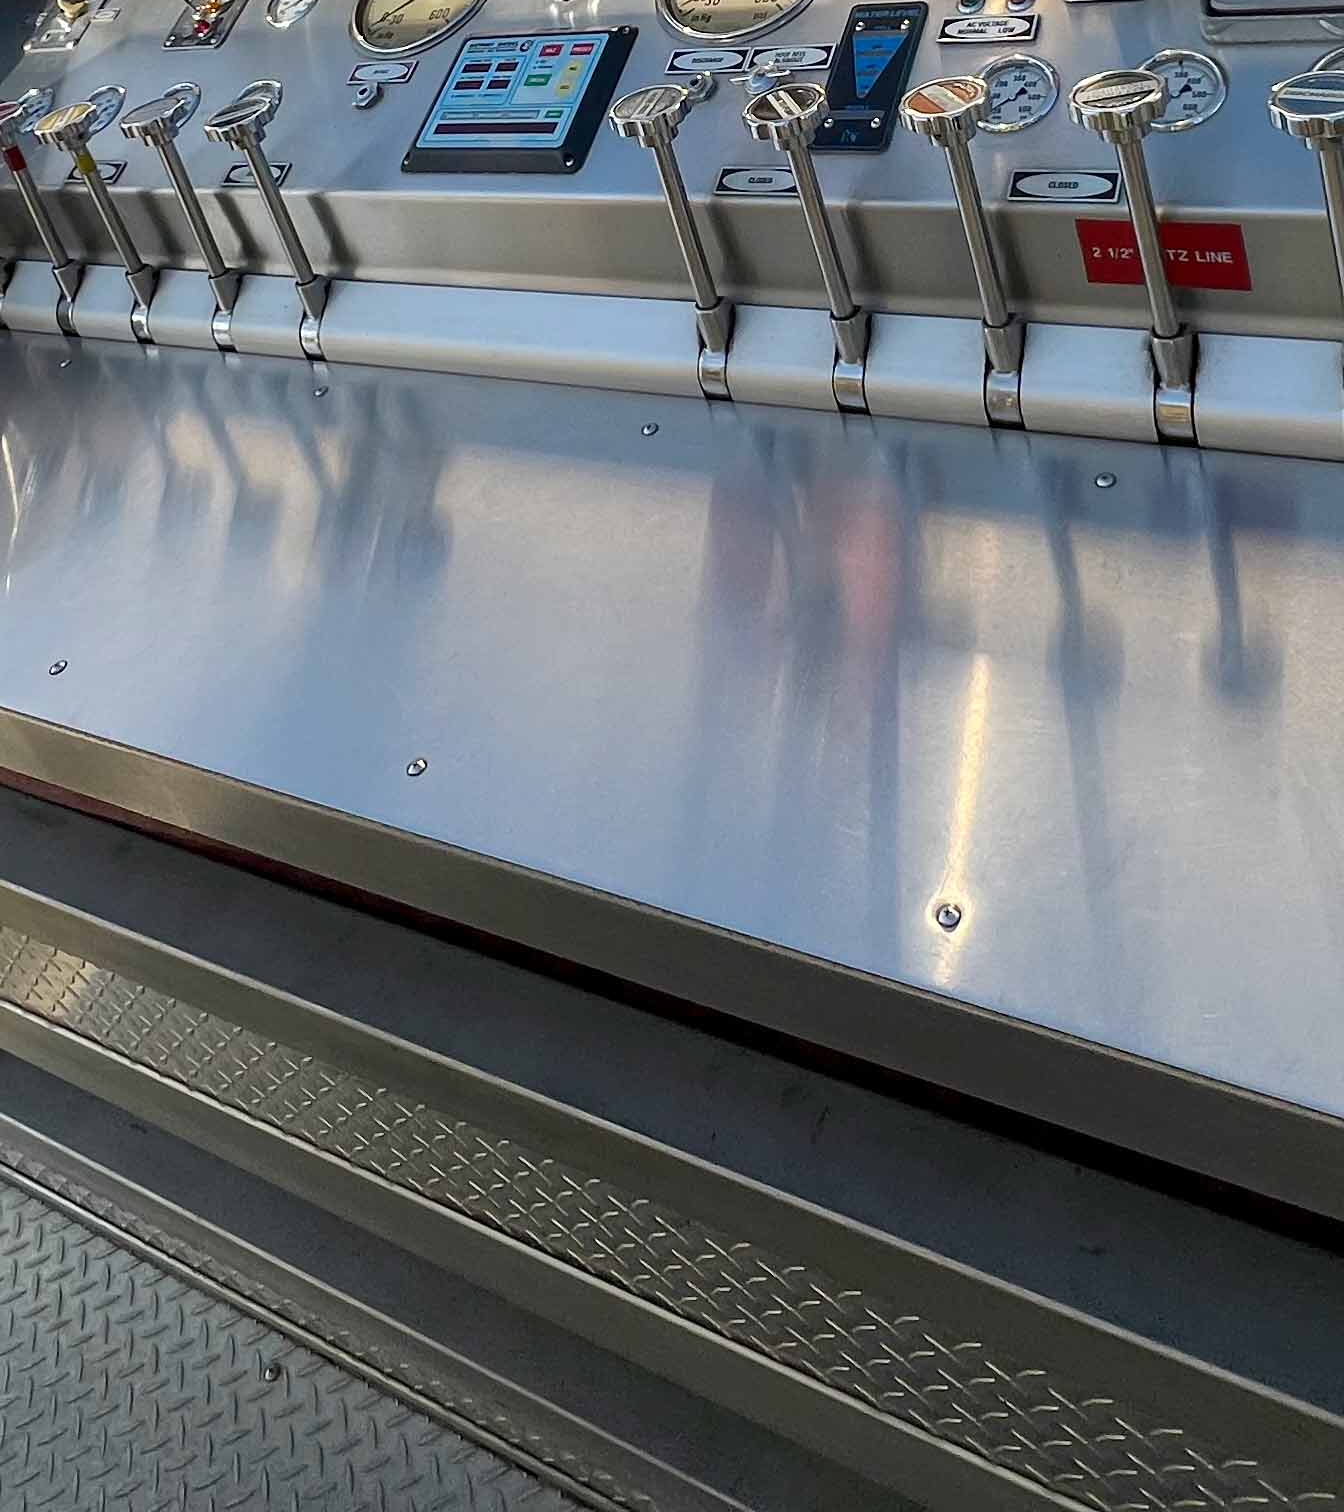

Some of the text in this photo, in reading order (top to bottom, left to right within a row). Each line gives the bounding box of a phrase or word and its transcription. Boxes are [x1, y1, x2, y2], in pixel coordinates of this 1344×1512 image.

[428, 7, 451, 21] 600
[997, 26, 1017, 34] LOW
[1047, 180, 1079, 189] CLOSED
[1092, 247, 1102, 259] 2
[1195, 251, 1234, 264] LINE
